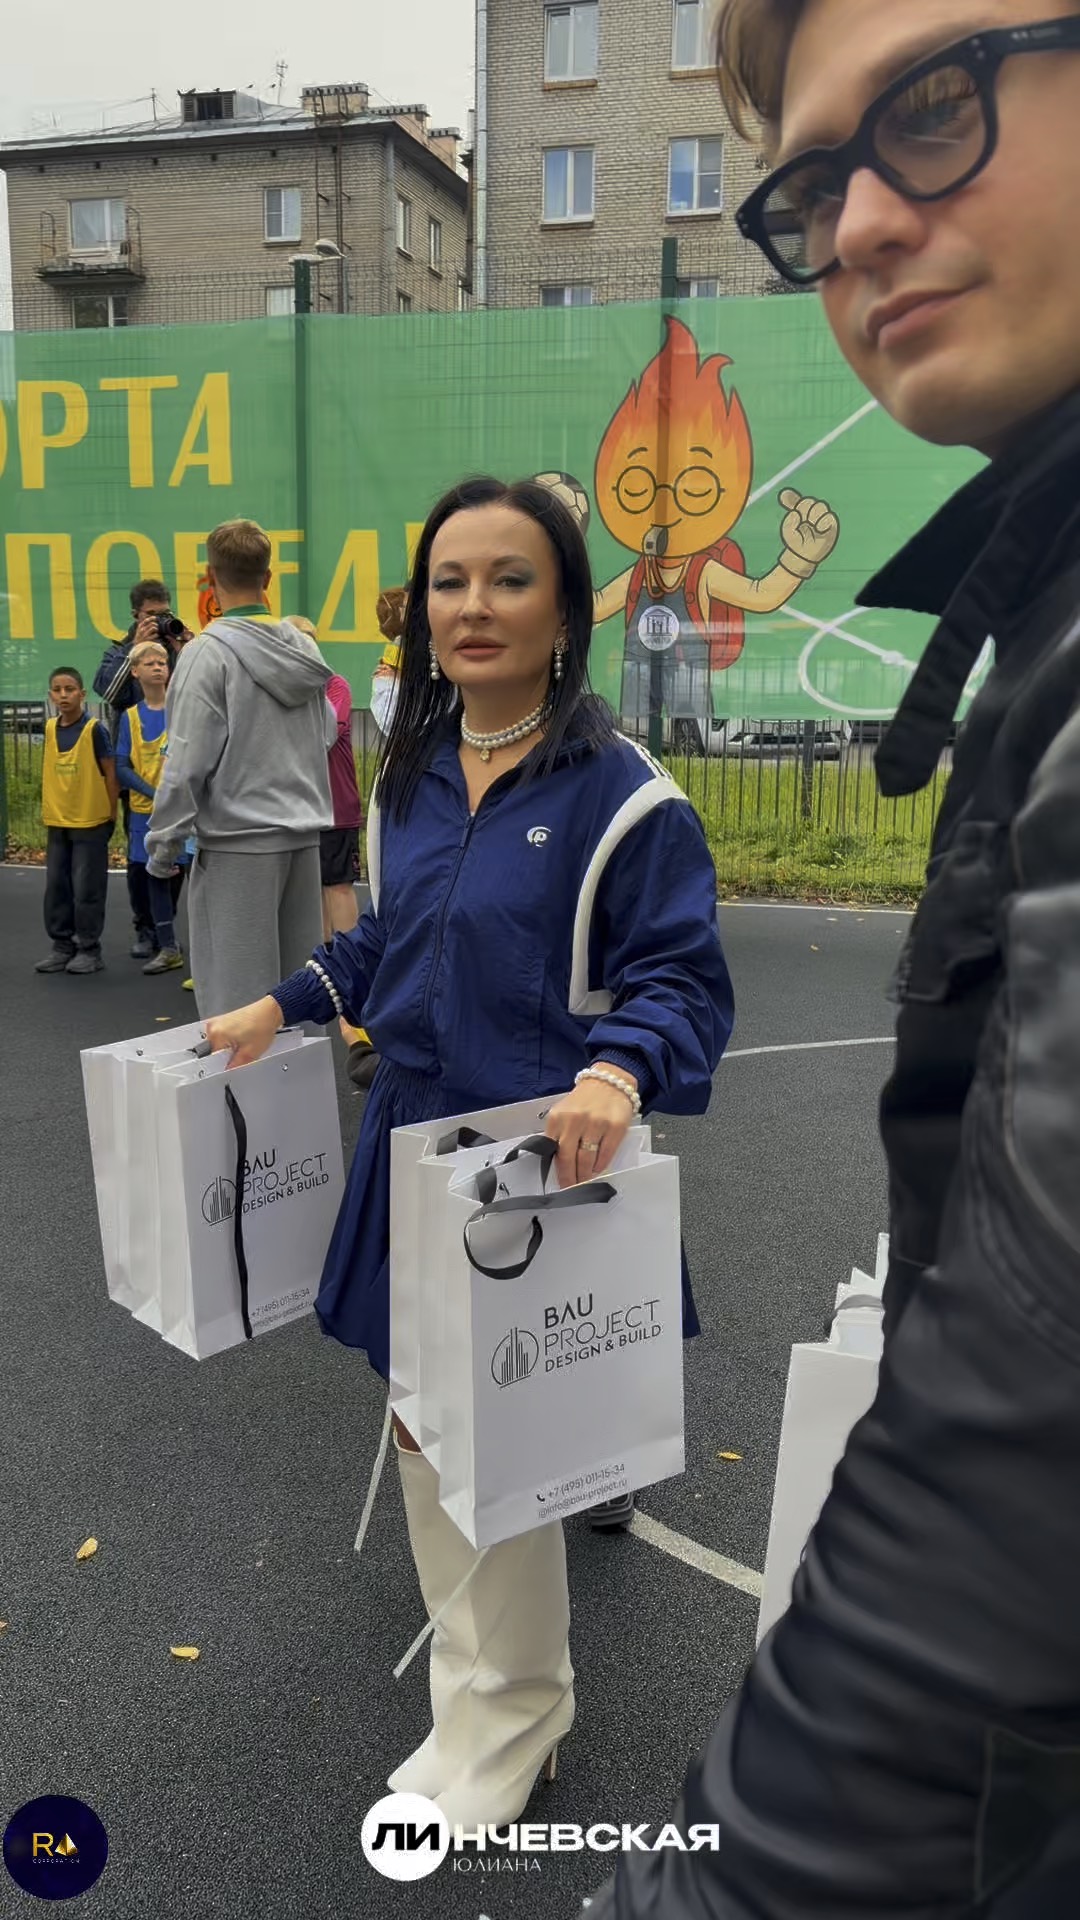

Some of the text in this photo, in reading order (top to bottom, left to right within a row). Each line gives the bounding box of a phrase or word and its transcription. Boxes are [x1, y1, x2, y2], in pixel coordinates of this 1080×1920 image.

[0, 372, 233, 489] РТА
[242, 1149, 276, 1176] BAU
[242, 1153, 327, 1195] PROJECT
[242, 1173, 329, 1214] DESIGN & BUILD
[544, 1293, 593, 1329] BAU
[544, 1299, 660, 1356] PROJECT
[545, 1324, 662, 1373] DESIGN & BUILD
